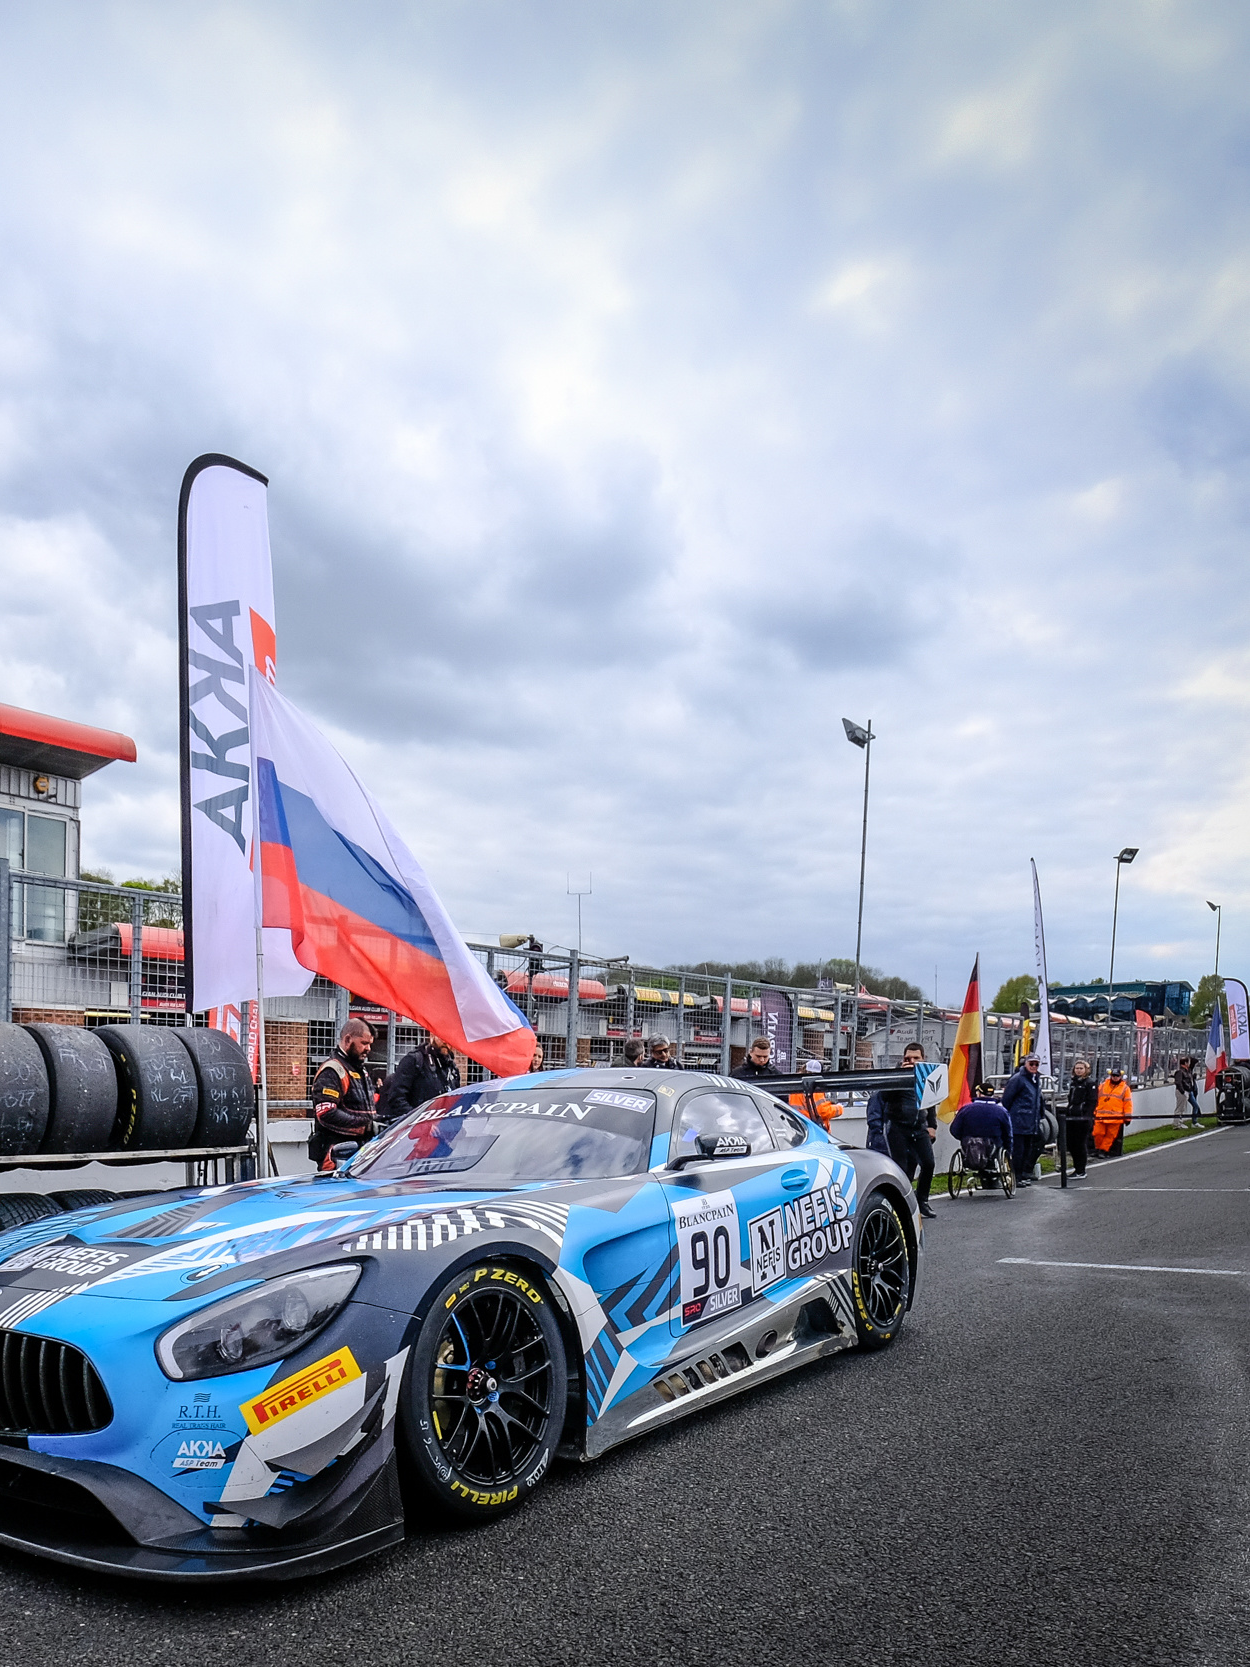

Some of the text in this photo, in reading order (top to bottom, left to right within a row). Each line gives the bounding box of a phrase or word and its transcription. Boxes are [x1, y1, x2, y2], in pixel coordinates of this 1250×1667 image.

[589, 1091, 648, 1110] SILVER
[410, 1102, 596, 1126] BLANCPAIN
[716, 1136, 748, 1147] AKKA
[678, 1203, 736, 1230] BLANCPAIN
[783, 1182, 849, 1242] NEFIS
[51, 1246, 130, 1267] NEFIS
[787, 1219, 854, 1271] GROUP
[31, 1257, 106, 1278] GROUP
[690, 1225, 732, 1299] 90
[756, 1246, 781, 1273] NEFIS
[473, 1267, 488, 1282] P
[490, 1268, 543, 1304] ZERO
[684, 1302, 702, 1317] SRO
[710, 1287, 739, 1312] SILVER
[252, 1358, 348, 1425] PIRELLI
[178, 1405, 221, 1419] R.T.H.
[176, 1440, 226, 1457] AKKA
[450, 1480, 519, 1505] PIRELLI
